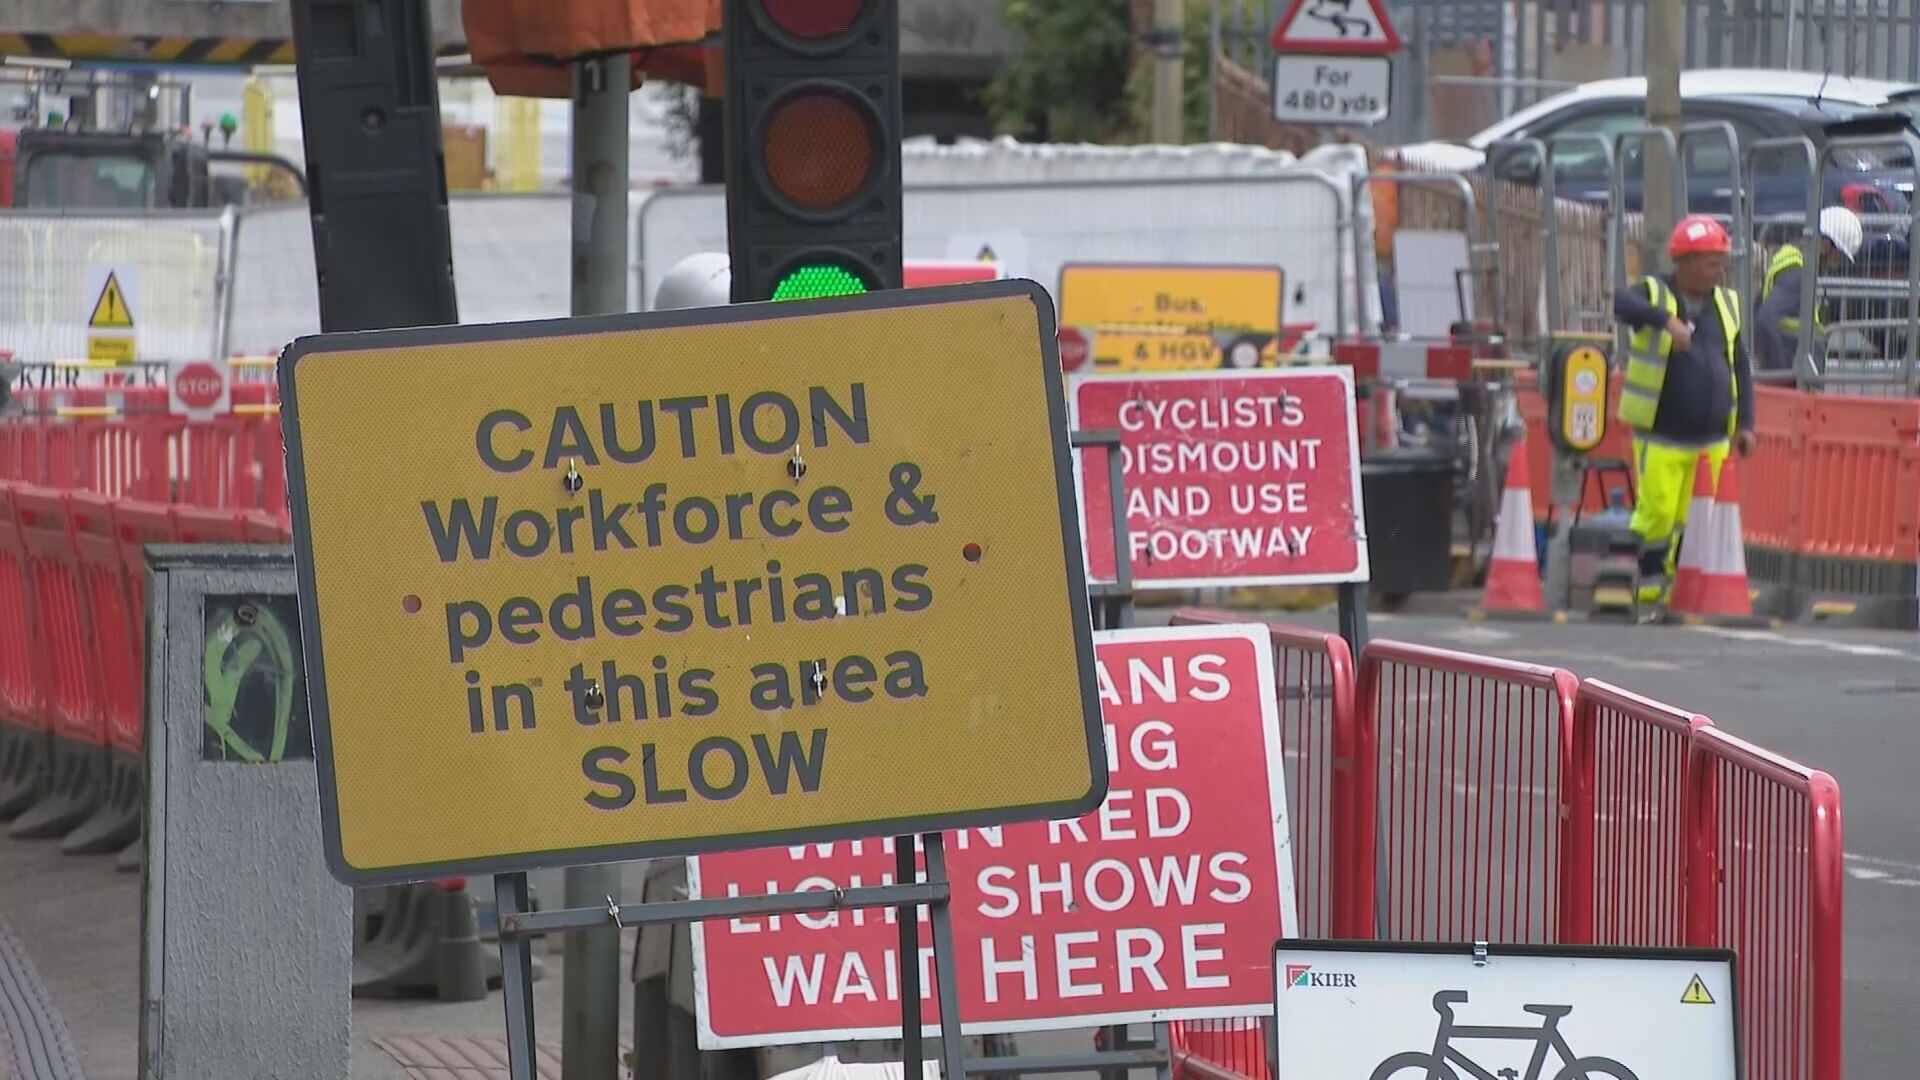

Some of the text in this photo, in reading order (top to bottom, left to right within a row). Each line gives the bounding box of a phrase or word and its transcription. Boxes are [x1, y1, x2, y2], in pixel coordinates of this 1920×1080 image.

[1315, 65, 1352, 86] For
[1284, 90, 1379, 115] 480 yds
[178, 378, 220, 395] STOP
[476, 382, 869, 473] CAUTION
[1119, 396, 1304, 431] CYCLISTS
[421, 462, 939, 563] Workforce &
[1127, 483, 1308, 518] AND USE
[1129, 526, 1313, 561] FOOTWAY
[445, 559, 933, 664] pedestrians
[465, 648, 928, 733] in this area
[581, 728, 828, 810] SLOW
[977, 851, 1251, 918] SHOWS
[981, 923, 1230, 1003] HERE
[1310, 972, 1357, 988] KIER
